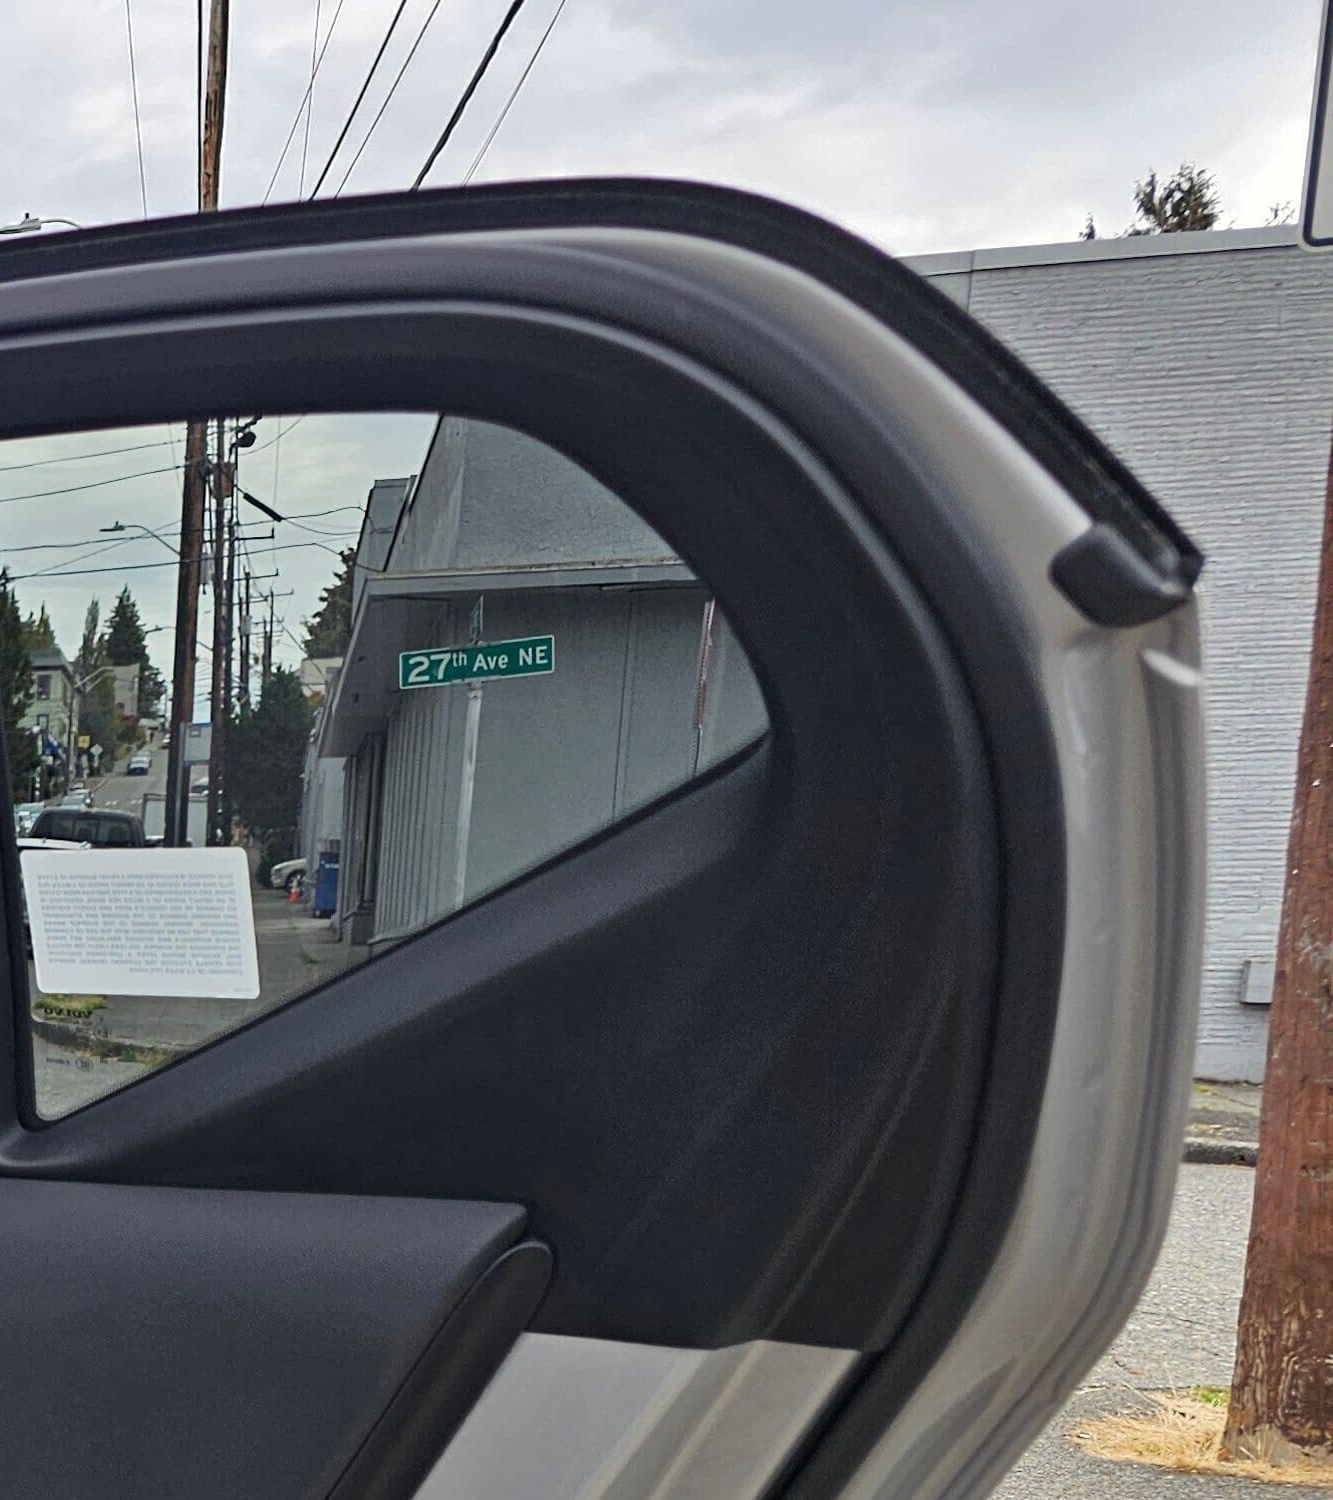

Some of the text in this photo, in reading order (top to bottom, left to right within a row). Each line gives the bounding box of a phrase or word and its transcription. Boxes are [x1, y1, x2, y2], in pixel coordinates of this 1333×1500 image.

[407, 645, 549, 684] 27th Ave NE
